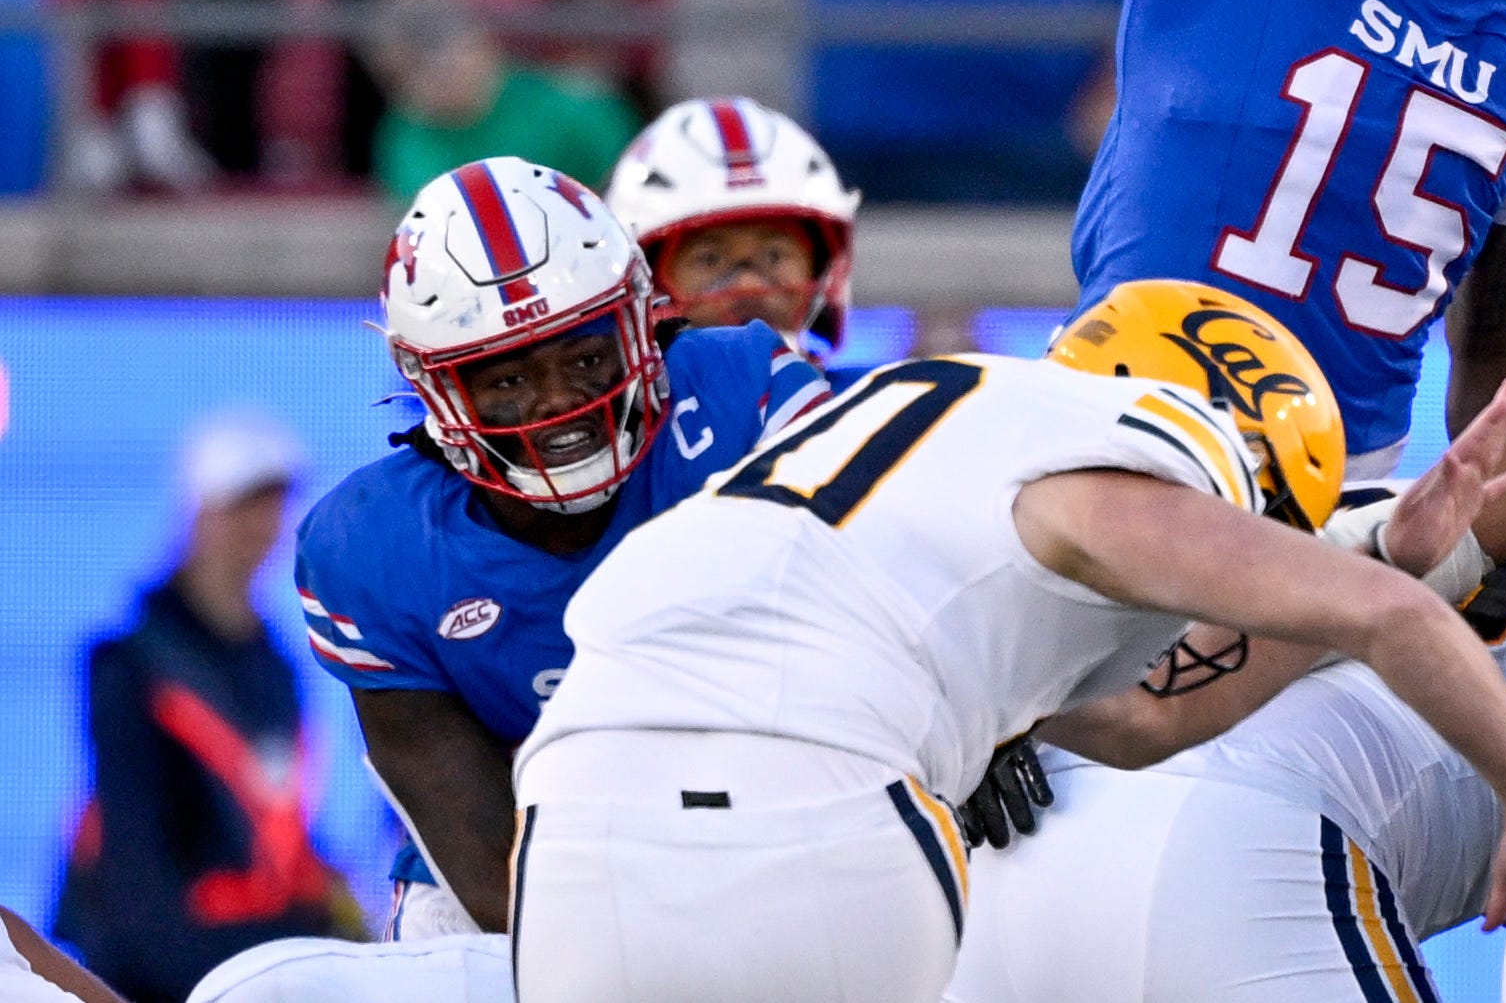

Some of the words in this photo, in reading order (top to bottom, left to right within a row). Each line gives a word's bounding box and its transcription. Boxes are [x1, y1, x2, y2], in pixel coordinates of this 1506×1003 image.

[502, 298, 550, 327] SMU
[1160, 310, 1311, 422] Cal
[671, 396, 714, 461] C
[446, 601, 493, 639] ACC
